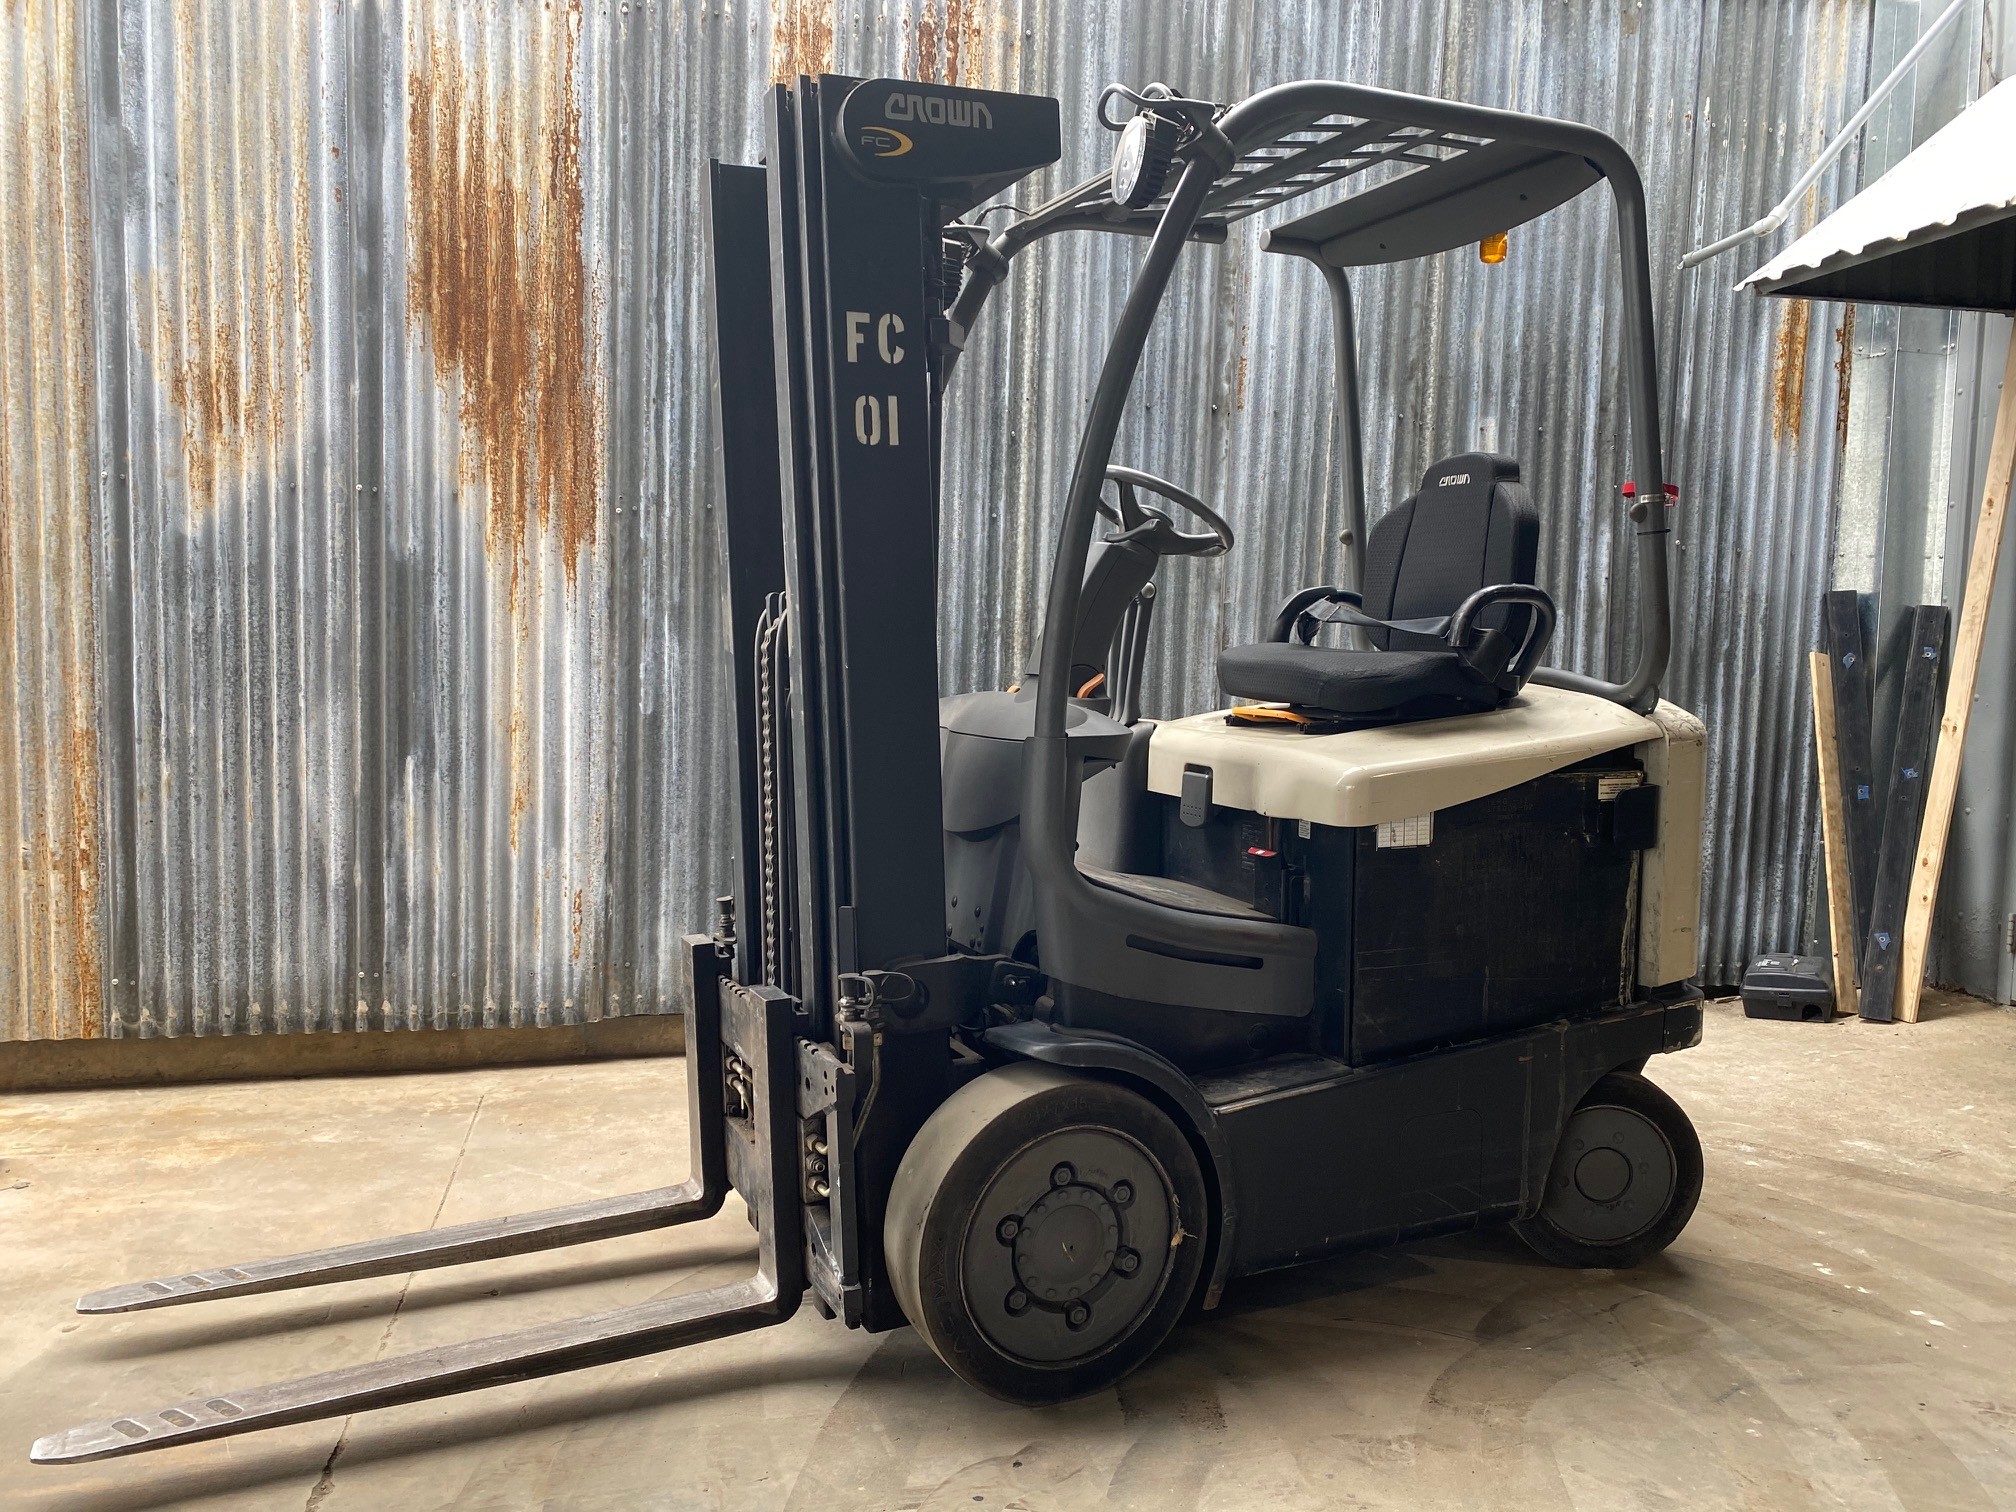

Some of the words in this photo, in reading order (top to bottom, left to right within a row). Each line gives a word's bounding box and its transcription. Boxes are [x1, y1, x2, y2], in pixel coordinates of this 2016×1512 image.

[884, 92, 993, 130] CROWN
[861, 135, 891, 148] FC
[846, 311, 905, 364] FC
[855, 395, 900, 446] 01
[1439, 473, 1471, 487] CROWN
